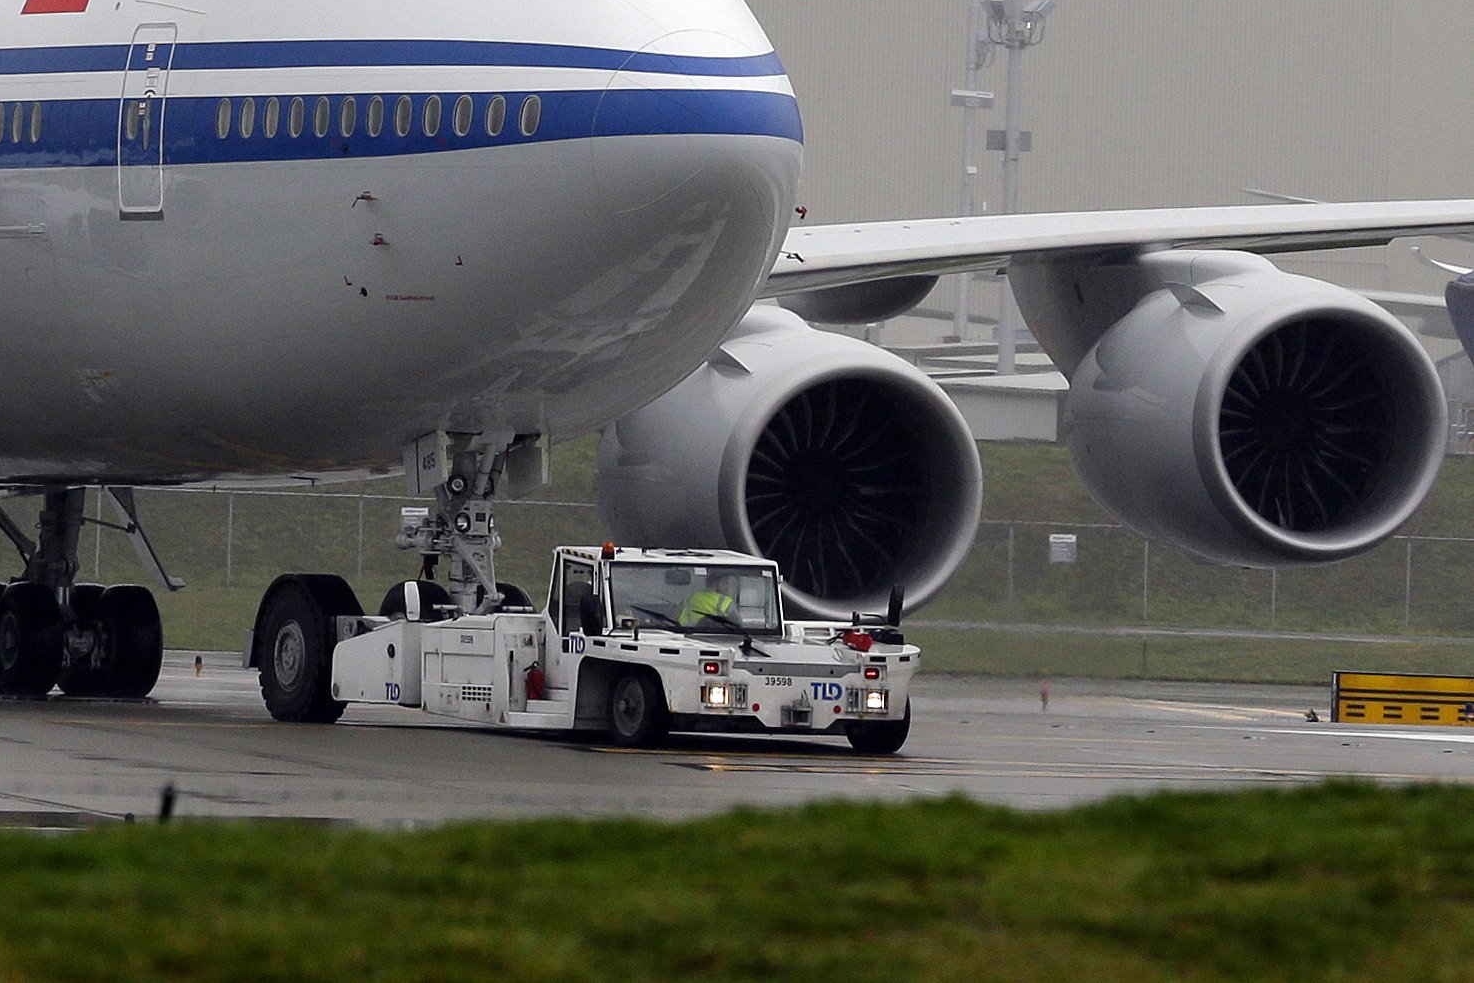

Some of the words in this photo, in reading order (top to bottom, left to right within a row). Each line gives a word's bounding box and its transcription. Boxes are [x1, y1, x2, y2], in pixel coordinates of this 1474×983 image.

[570, 635, 586, 654] TLD
[385, 682, 401, 700] TLD
[765, 677, 793, 687] 39598
[811, 682, 843, 700] TLD
